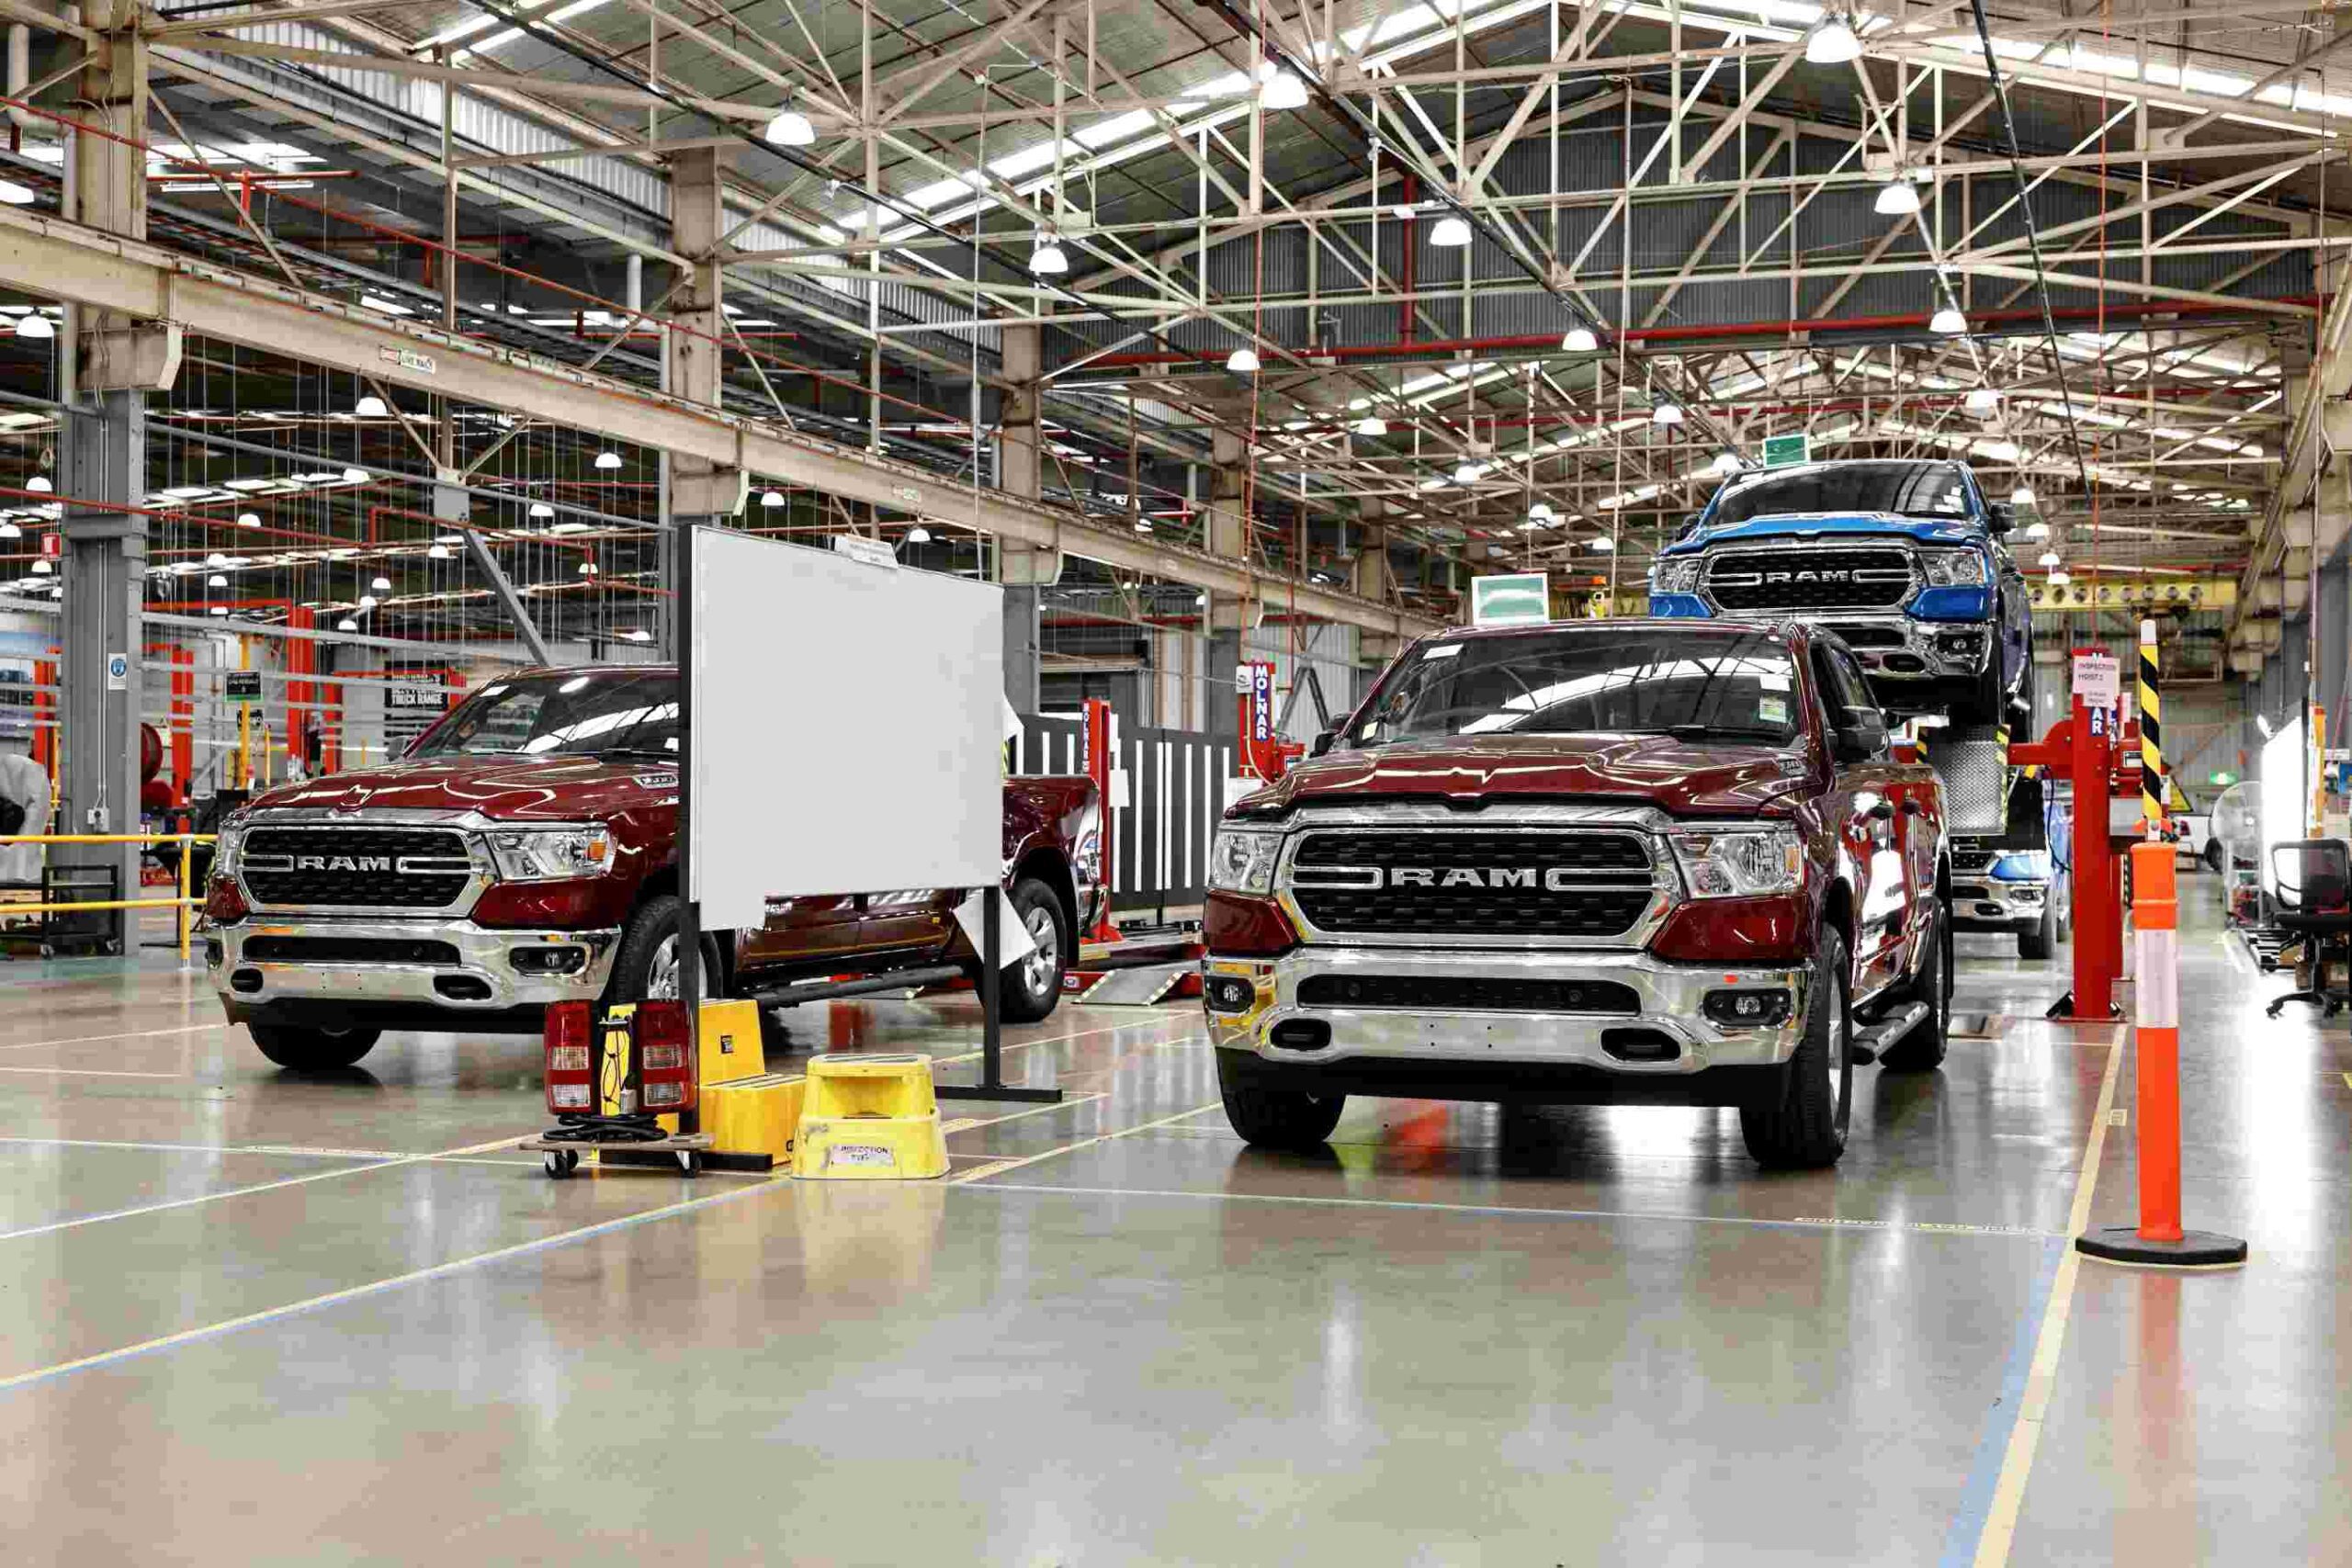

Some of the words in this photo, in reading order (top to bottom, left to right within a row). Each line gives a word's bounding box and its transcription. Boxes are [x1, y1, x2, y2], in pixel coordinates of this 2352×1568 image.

[1766, 570, 1849, 583] RAM
[1255, 664, 1268, 740] MOLNAR
[297, 855, 390, 872] RAM
[1391, 868, 1537, 887] RAM
